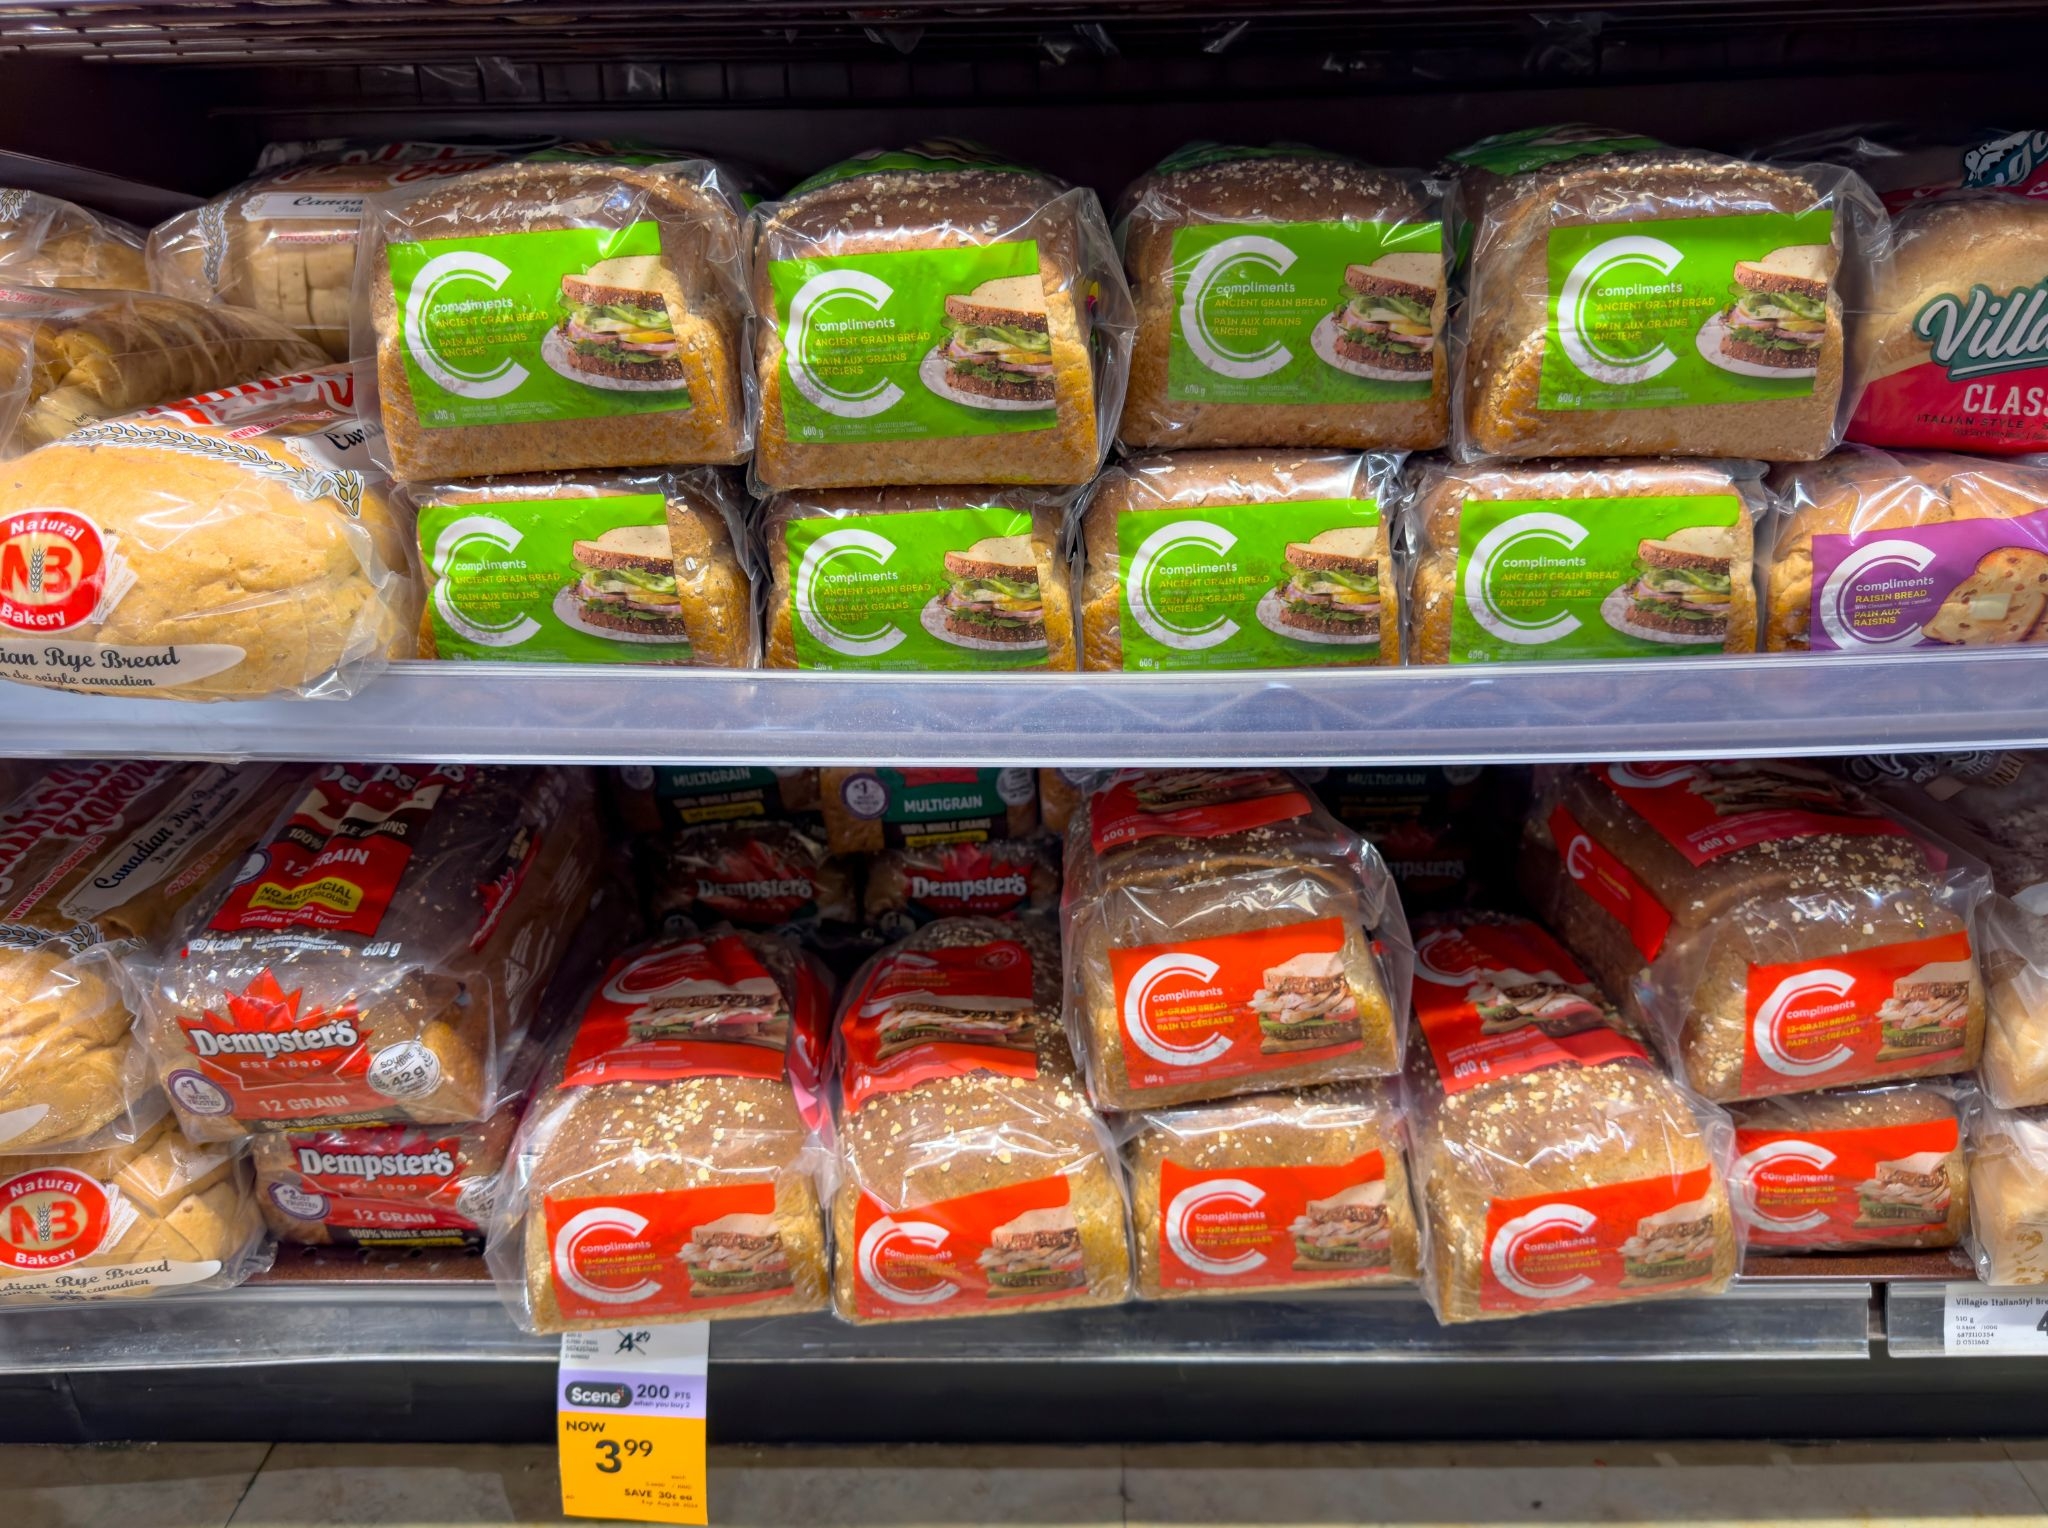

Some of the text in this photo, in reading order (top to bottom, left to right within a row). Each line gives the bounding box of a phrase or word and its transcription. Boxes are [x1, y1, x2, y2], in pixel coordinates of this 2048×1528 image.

[1216, 281, 1295, 300] compliments
[1597, 282, 1683, 298] compliments
[1214, 298, 1327, 308] ANCIENT GRAIN BREAD
[814, 316, 895, 334] compliments
[1214, 317, 1302, 327] PAIN AUX GRAINS
[860, 334, 895, 343] GRAIN
[897, 332, 930, 342] BREAD
[1213, 327, 1258, 336] ANCIENS
[866, 353, 906, 363] GRAINS
[1963, 384, 2048, 417] CLAS
[10, 518, 84, 541] Natural
[455, 559, 527, 574] compliments
[1159, 562, 1237, 577] compliments
[1502, 556, 1586, 570] compliments
[497, 574, 527, 583] GRAIN
[824, 570, 898, 585] compliments
[1238, 575, 1270, 585] BREAD
[1586, 571, 1619, 579] BREAD
[1856, 576, 1935, 592] compliments
[1855, 594, 1892, 604] RAISIN
[1894, 590, 1927, 600] BREAD
[0, 603, 65, 626] Bakery
[1855, 608, 1901, 619] PAIN AUX
[1854, 616, 1896, 627] RAISINS
[44, 647, 95, 672] Rye
[101, 646, 180, 669] Bread
[34, 671, 78, 685] seigle
[82, 675, 155, 686] canadien
[903, 795, 983, 813] MULTIGRAIN
[361, 942, 390, 957] 600
[389, 942, 403, 959] g
[1152, 986, 1223, 1003] compliments
[1786, 1000, 1856, 1019] compliments
[189, 1020, 358, 1057] Dempster's
[240, 1060, 270, 1069] EST
[1453, 1060, 1490, 1079] 600 g
[261, 1095, 350, 1113] 12 GRAIN
[299, 1148, 454, 1181] Dempster's
[10, 1178, 82, 1198] Natural
[353, 1208, 435, 1224] 12 GRAIN
[349, 1229, 380, 1238] 100%
[580, 1240, 651, 1254] compliments
[15, 1248, 76, 1265] Bakery
[55, 1274, 101, 1289] Rye
[105, 1260, 171, 1280] Bread
[86, 1278, 151, 1294] canadien
[1955, 1297, 1988, 1308] Villagio
[571, 1385, 621, 1404] Scene
[637, 1384, 691, 1400] 200 PTS
[634, 1400, 654, 1408] when
[656, 1401, 669, 1409] you
[671, 1401, 685, 1409] buy
[566, 1420, 606, 1432] NOW
[624, 1488, 652, 1498] SAVE
